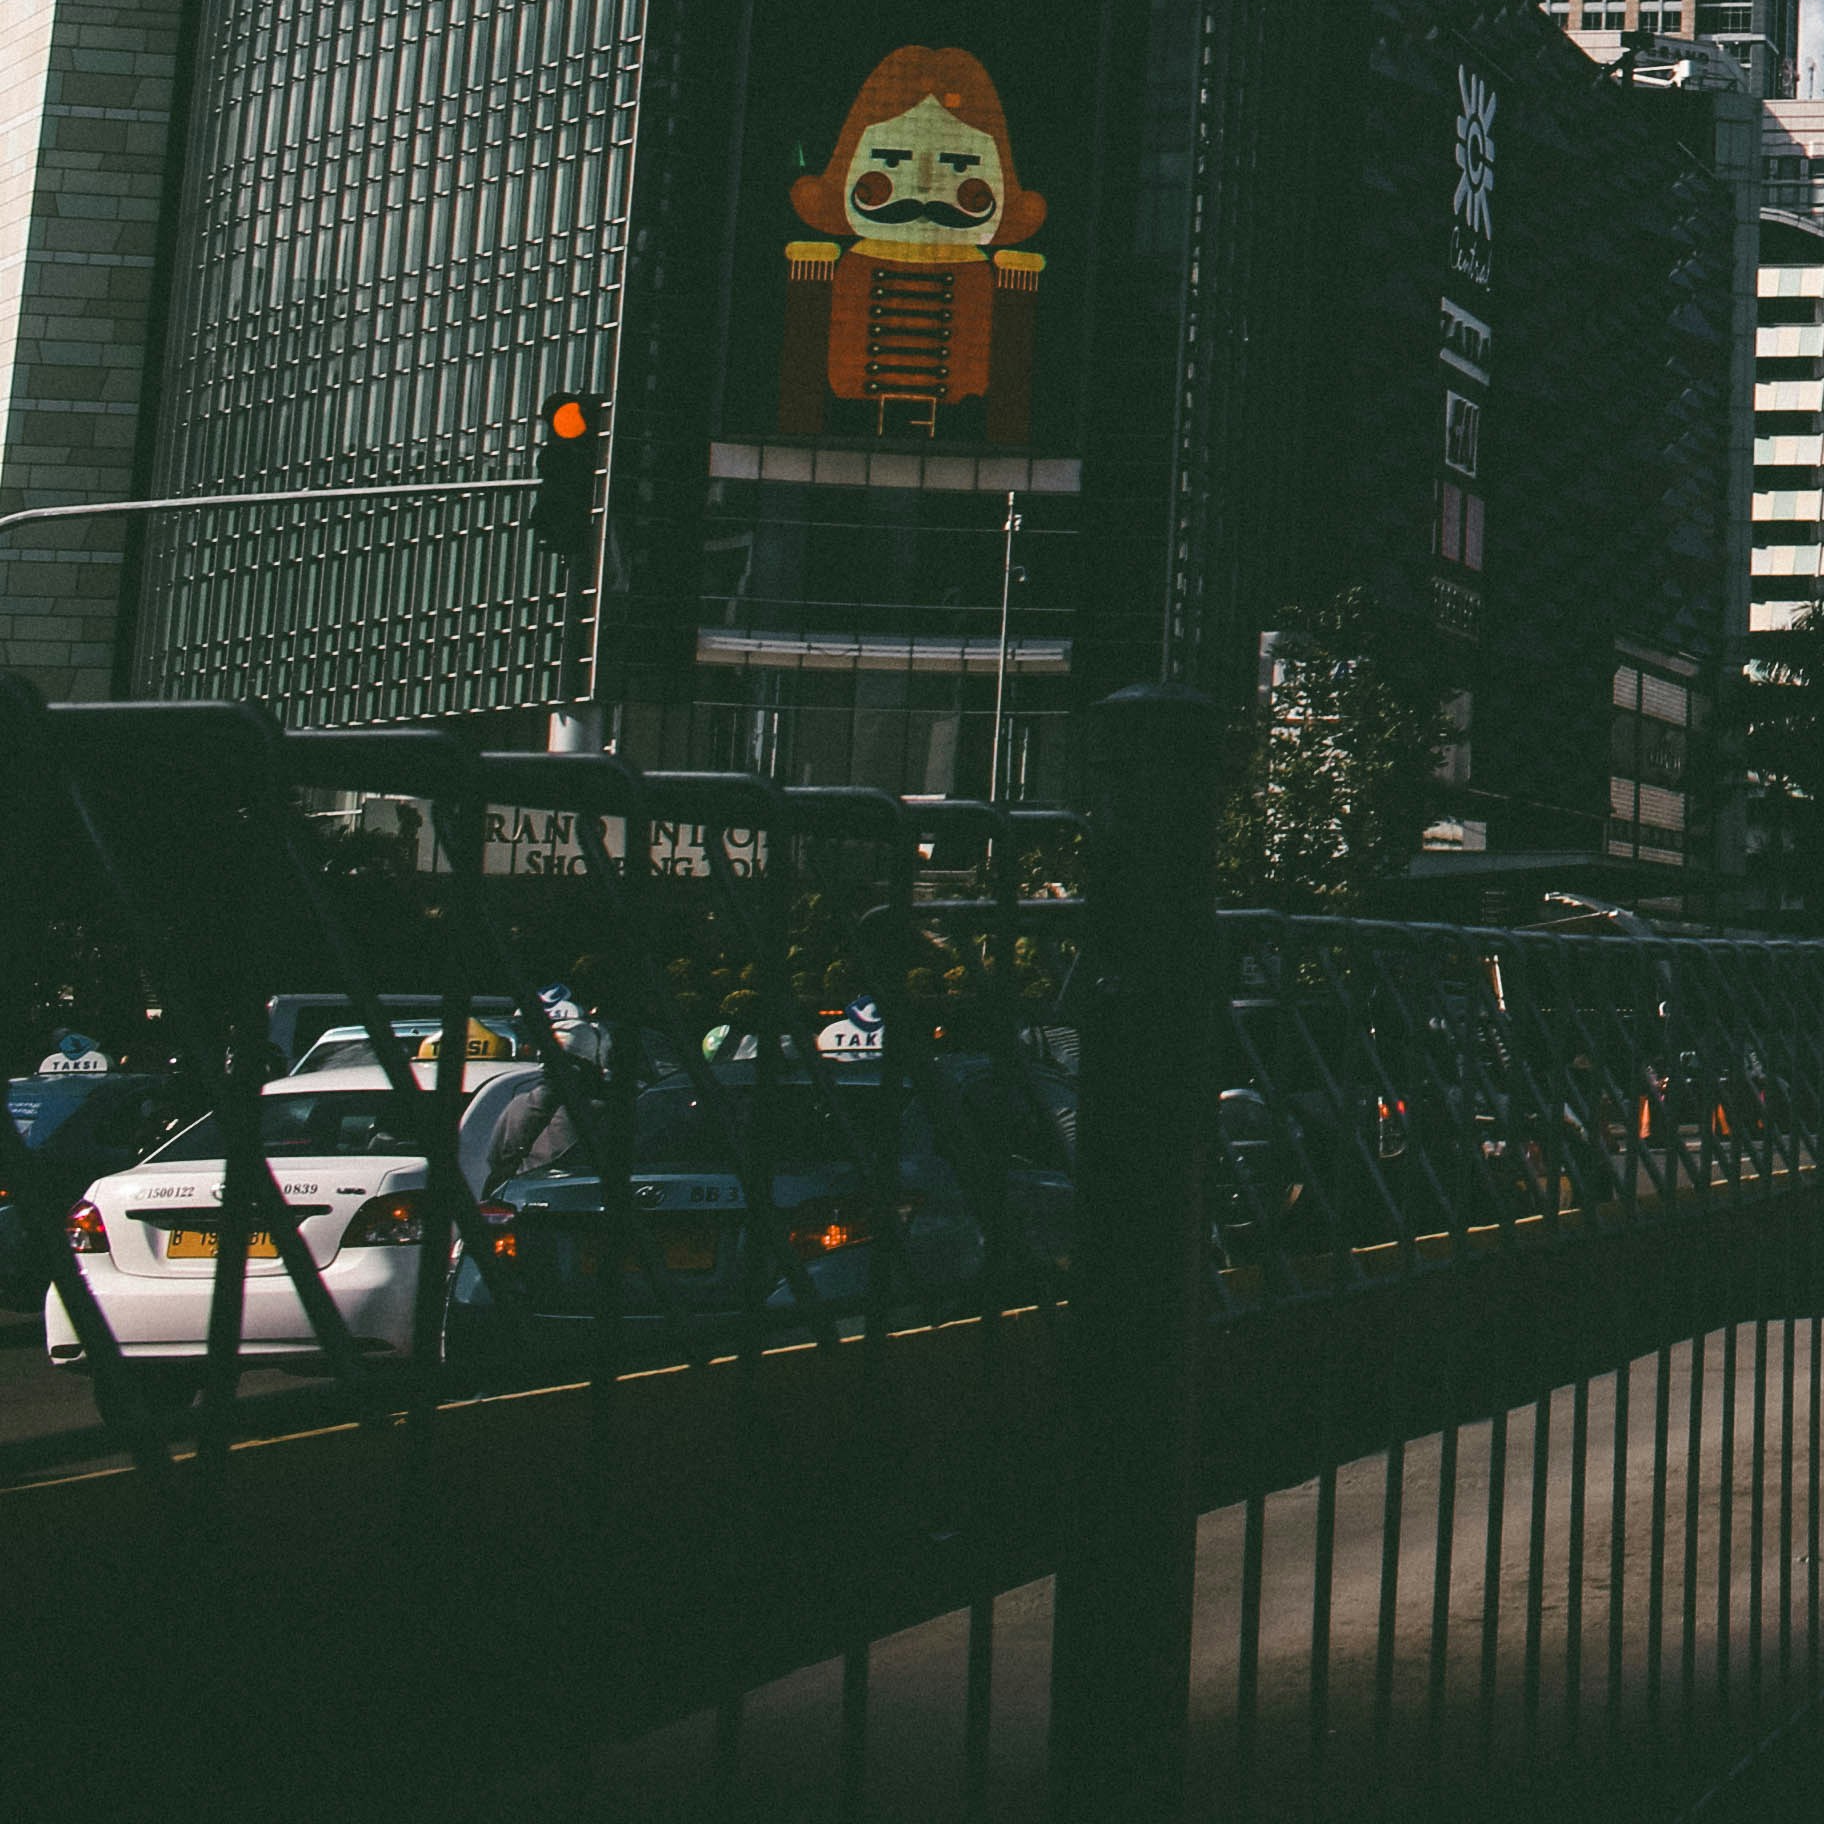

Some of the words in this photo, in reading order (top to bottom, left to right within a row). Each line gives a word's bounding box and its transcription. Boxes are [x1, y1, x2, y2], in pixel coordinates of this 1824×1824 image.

[834, 1033, 878, 1047] TAK
[431, 1040, 489, 1056] TSI
[52, 1061, 98, 1069] TAKSI
[147, 1185, 196, 1199] 1500122
[284, 1183, 319, 1195] 0839
